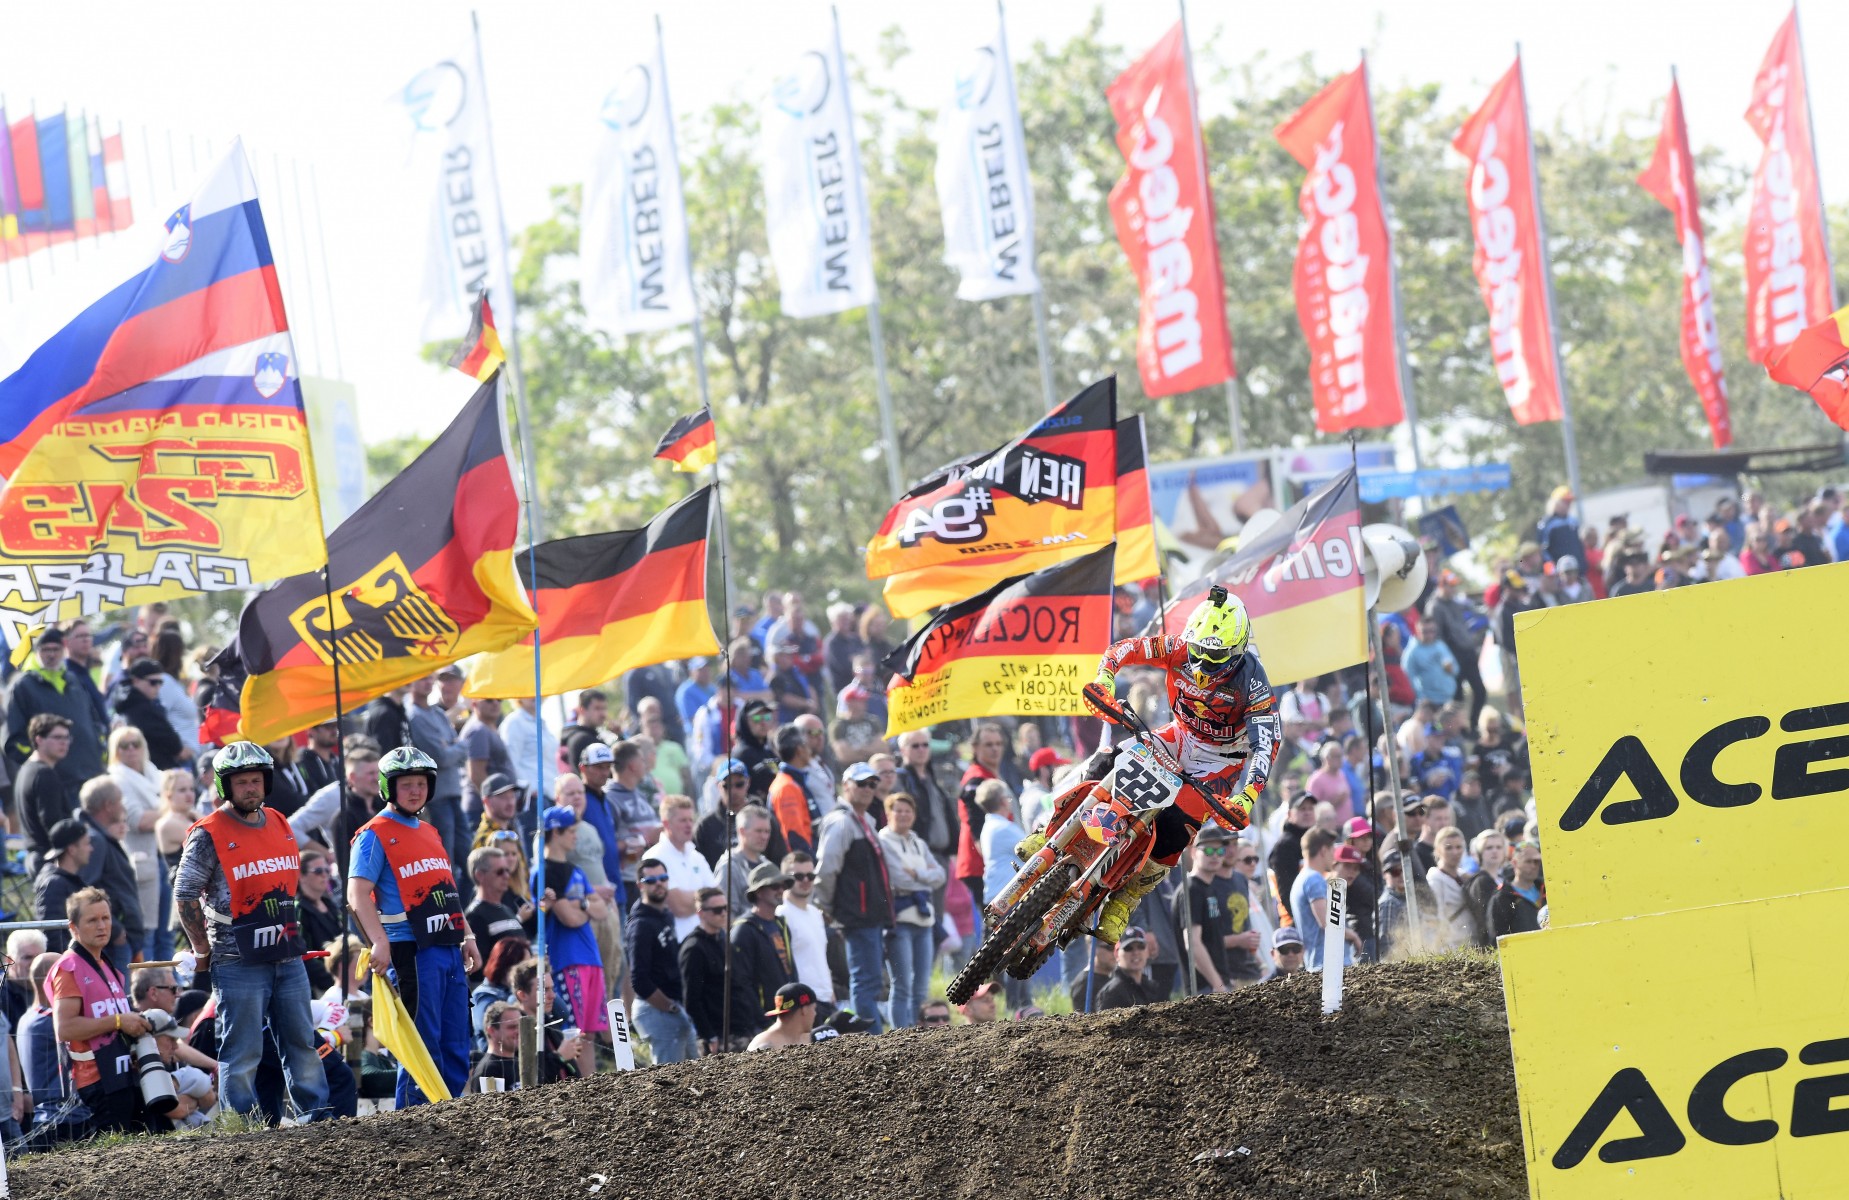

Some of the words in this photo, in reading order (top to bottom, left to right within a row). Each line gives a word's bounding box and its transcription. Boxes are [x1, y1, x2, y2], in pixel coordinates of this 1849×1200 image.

[1200, 720, 1233, 738] Bull
[1114, 758, 1171, 809] 222
[232, 855, 299, 881] MARSHALL
[1330, 889, 1342, 926] UFO
[614, 1010, 629, 1043] UFO
